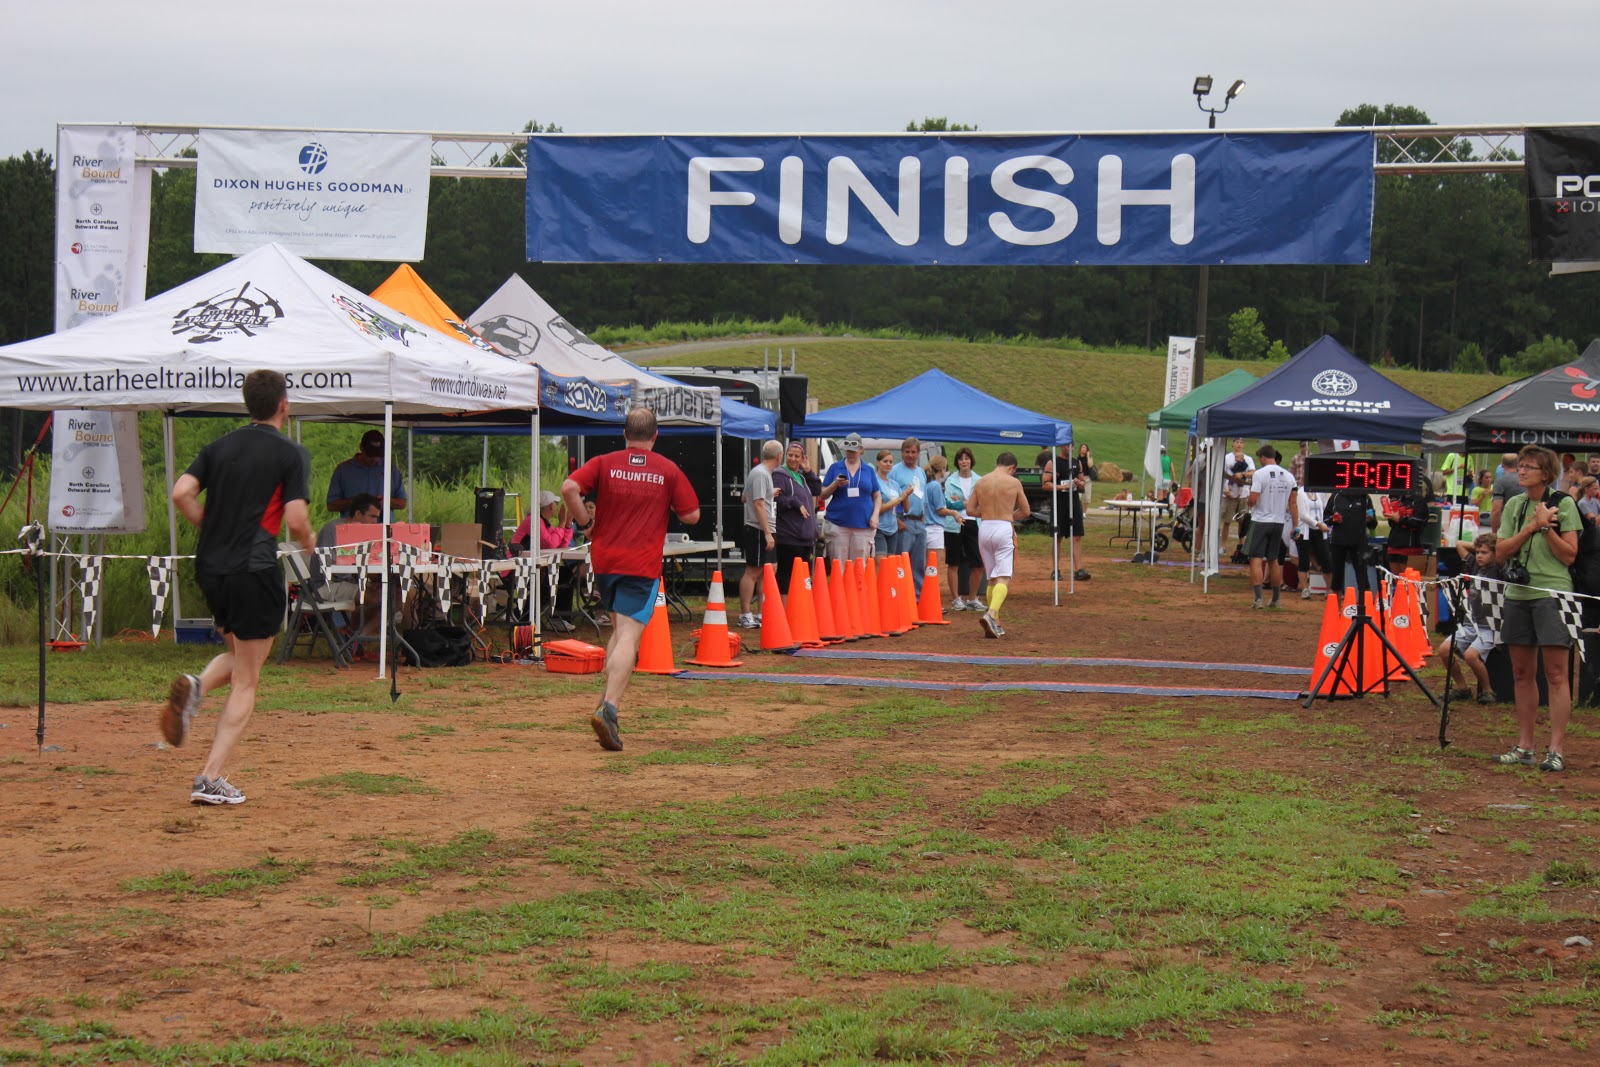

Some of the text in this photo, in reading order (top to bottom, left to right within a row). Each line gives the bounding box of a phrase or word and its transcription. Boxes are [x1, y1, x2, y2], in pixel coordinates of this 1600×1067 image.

[73, 155, 103, 167] River
[82, 167, 120, 179] Bound
[213, 178, 260, 190] DIXON
[264, 180, 323, 192] HUGHES
[327, 182, 404, 194] GOODMAN
[686, 153, 1195, 247] FINISH
[248, 197, 367, 222] positively unique
[70, 288, 101, 300] River
[79, 300, 119, 312] Bound
[188, 313, 264, 325] TRAILBLAZERS
[17, 366, 353, 393] www.tarheeltrailblas.com
[430, 374, 508, 400] www.dirtdivas.net
[564, 381, 608, 413] KONA
[1273, 398, 1391, 409] Outward
[68, 418, 97, 430] River
[1577, 433, 1600, 444] ADV
[610, 469, 665, 485] VOLUNTEER
[1335, 461, 1412, 490] 39:09
